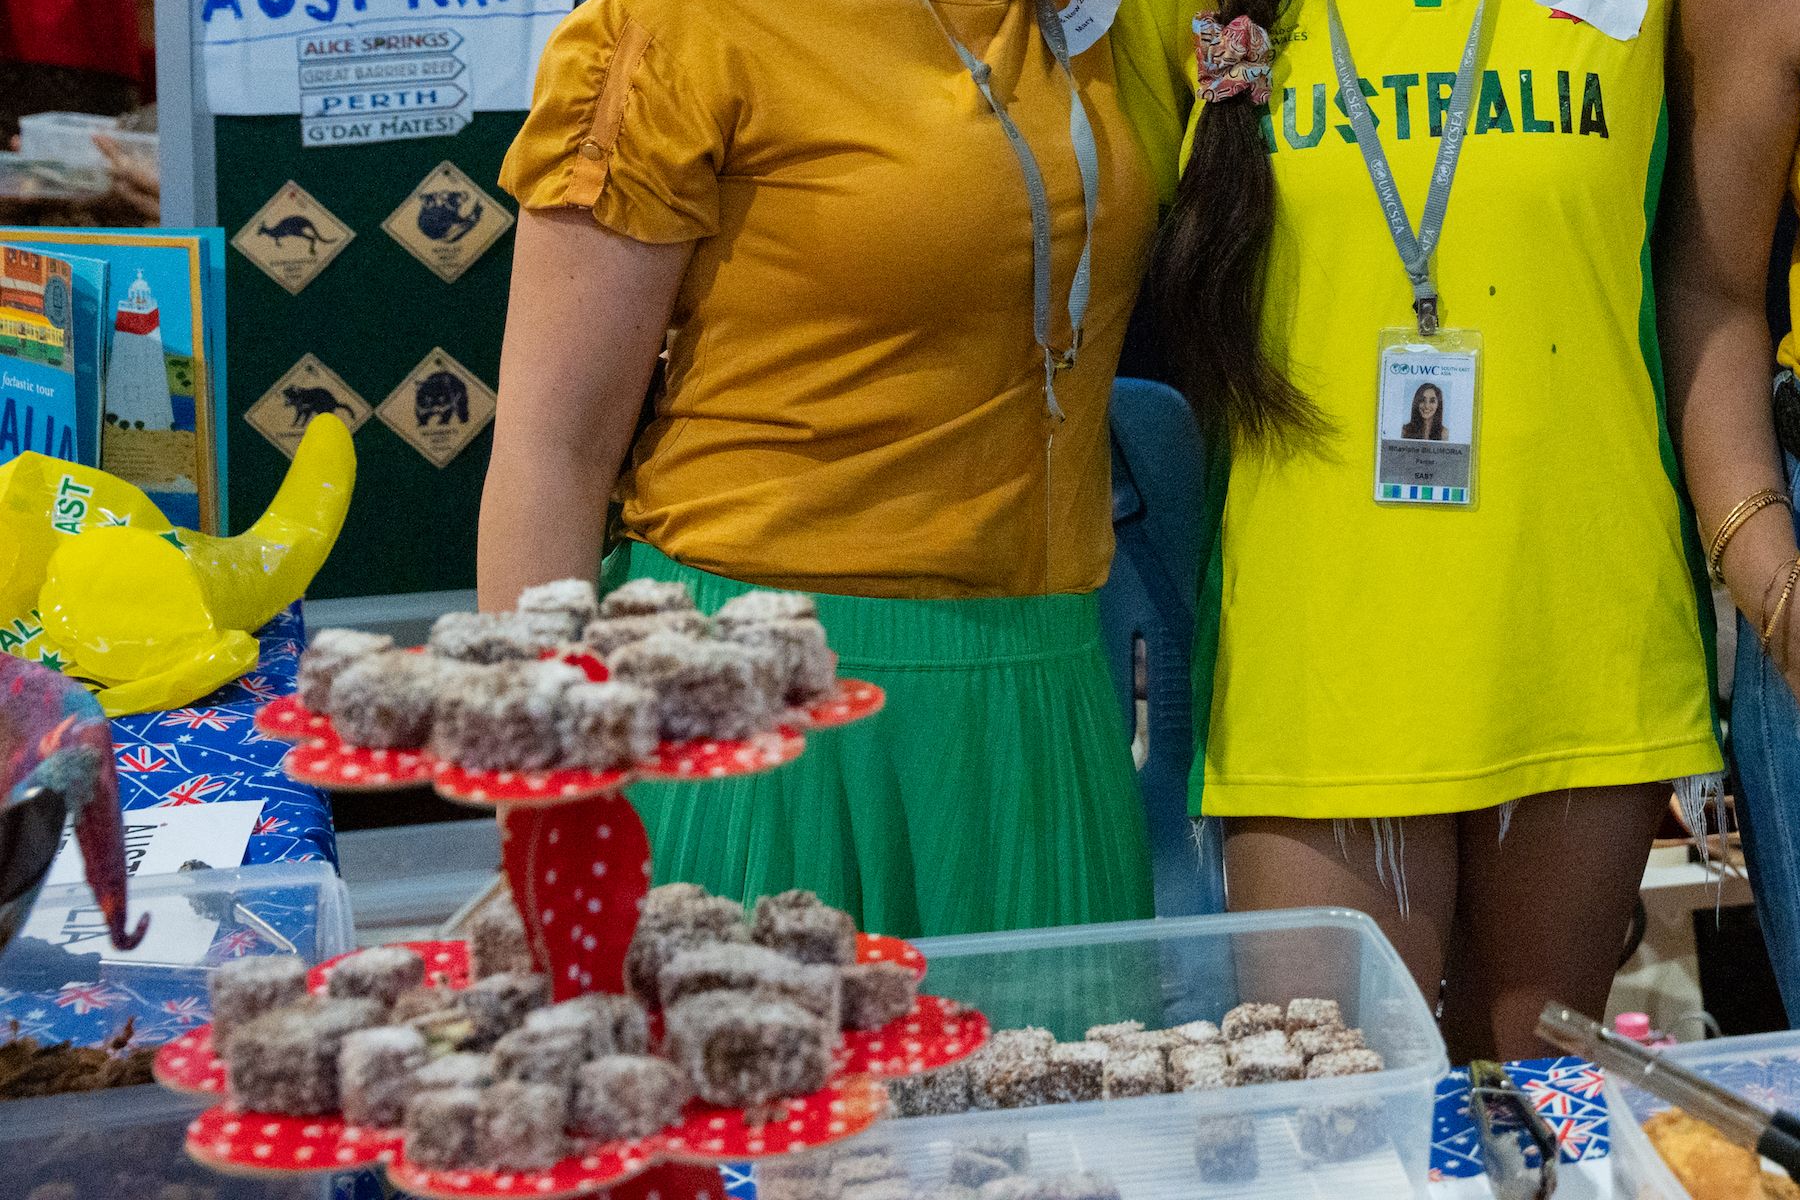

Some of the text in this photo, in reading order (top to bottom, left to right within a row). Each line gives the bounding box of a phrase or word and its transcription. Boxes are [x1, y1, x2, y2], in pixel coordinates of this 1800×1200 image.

[1075, 16, 1095, 33] Mary
[304, 31, 450, 56] ALICE SPRINGS
[303, 61, 456, 85] GREAT BARRIER REEF
[322, 89, 438, 113] PERTH
[1338, 66, 1364, 120] UWCSEA
[308, 115, 455, 142] G'DAY MATES!
[1441, 109, 1465, 166] UWCSEA
[1378, 180, 1405, 236] UWCSEA
[1410, 365, 1440, 376] UWC
[0, 371, 55, 398] factastic tour
